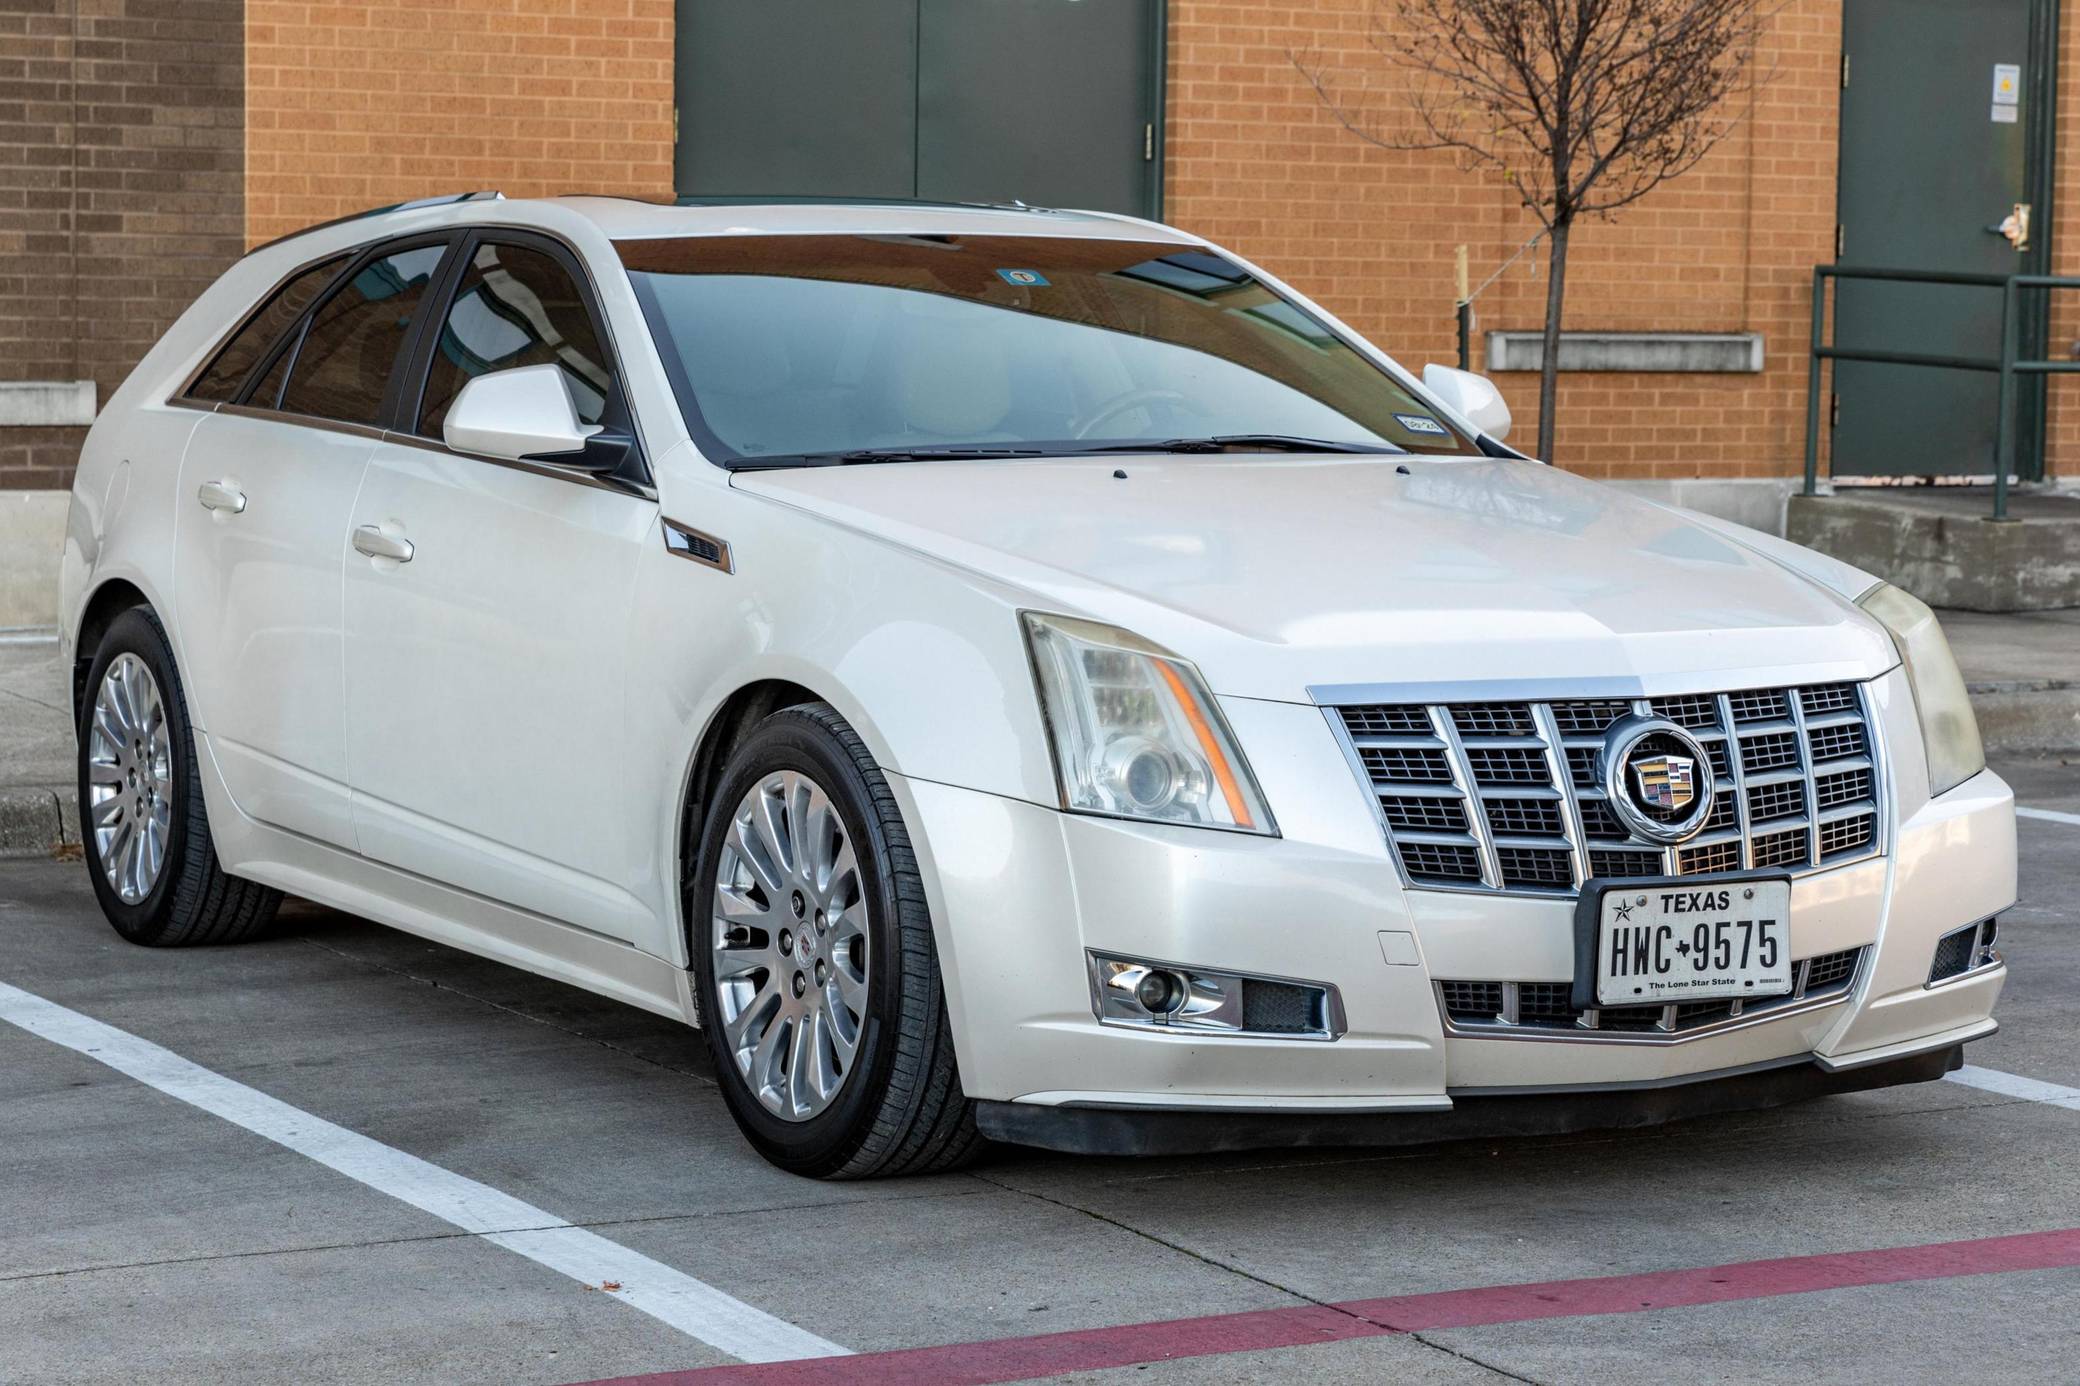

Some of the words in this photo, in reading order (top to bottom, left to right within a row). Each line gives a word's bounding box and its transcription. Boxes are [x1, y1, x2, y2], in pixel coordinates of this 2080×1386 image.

[1661, 891, 1730, 913] TEXAS
[1649, 982, 1666, 990] The
[1667, 980, 1689, 989] Lone
[1691, 978, 1710, 987] Star
[1711, 977, 1736, 986] State
